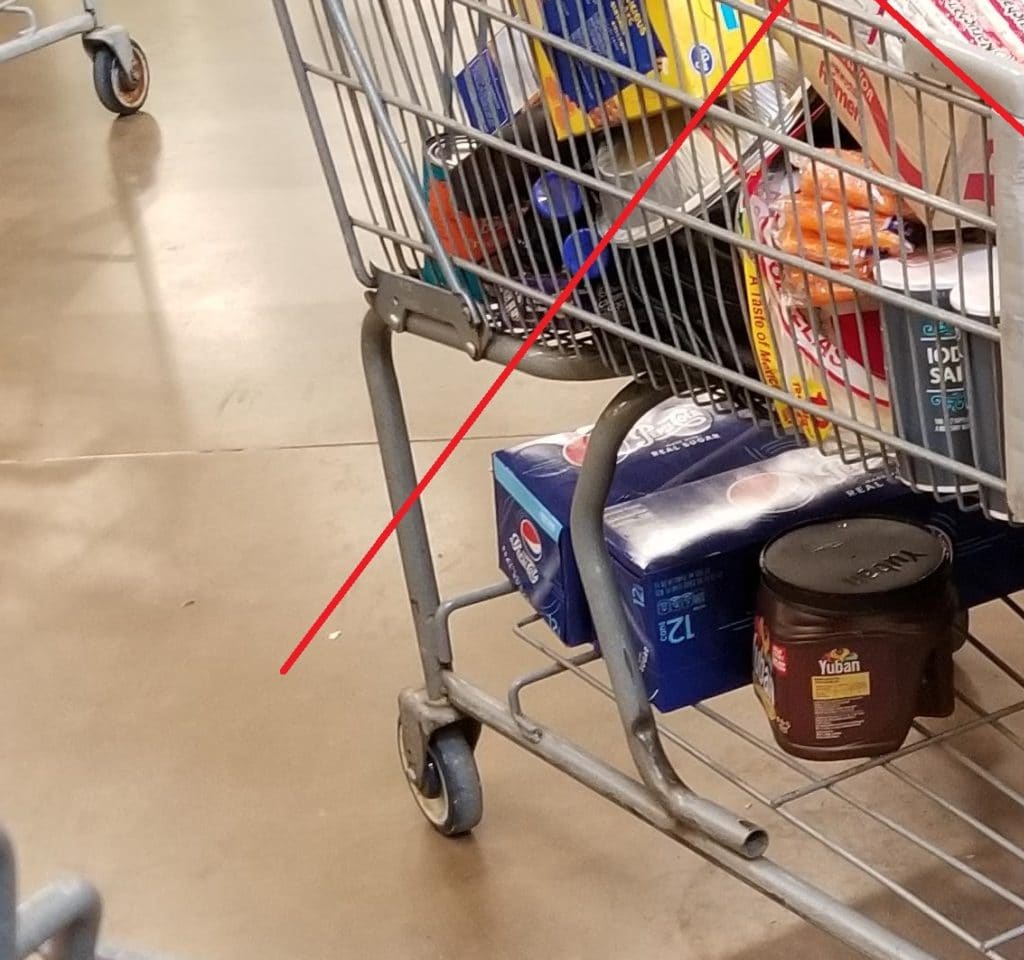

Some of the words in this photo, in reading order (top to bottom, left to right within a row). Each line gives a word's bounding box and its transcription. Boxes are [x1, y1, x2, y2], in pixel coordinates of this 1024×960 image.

[755, 331, 769, 348] of
[666, 614, 695, 644] 12
[818, 659, 860, 675] Yuban
